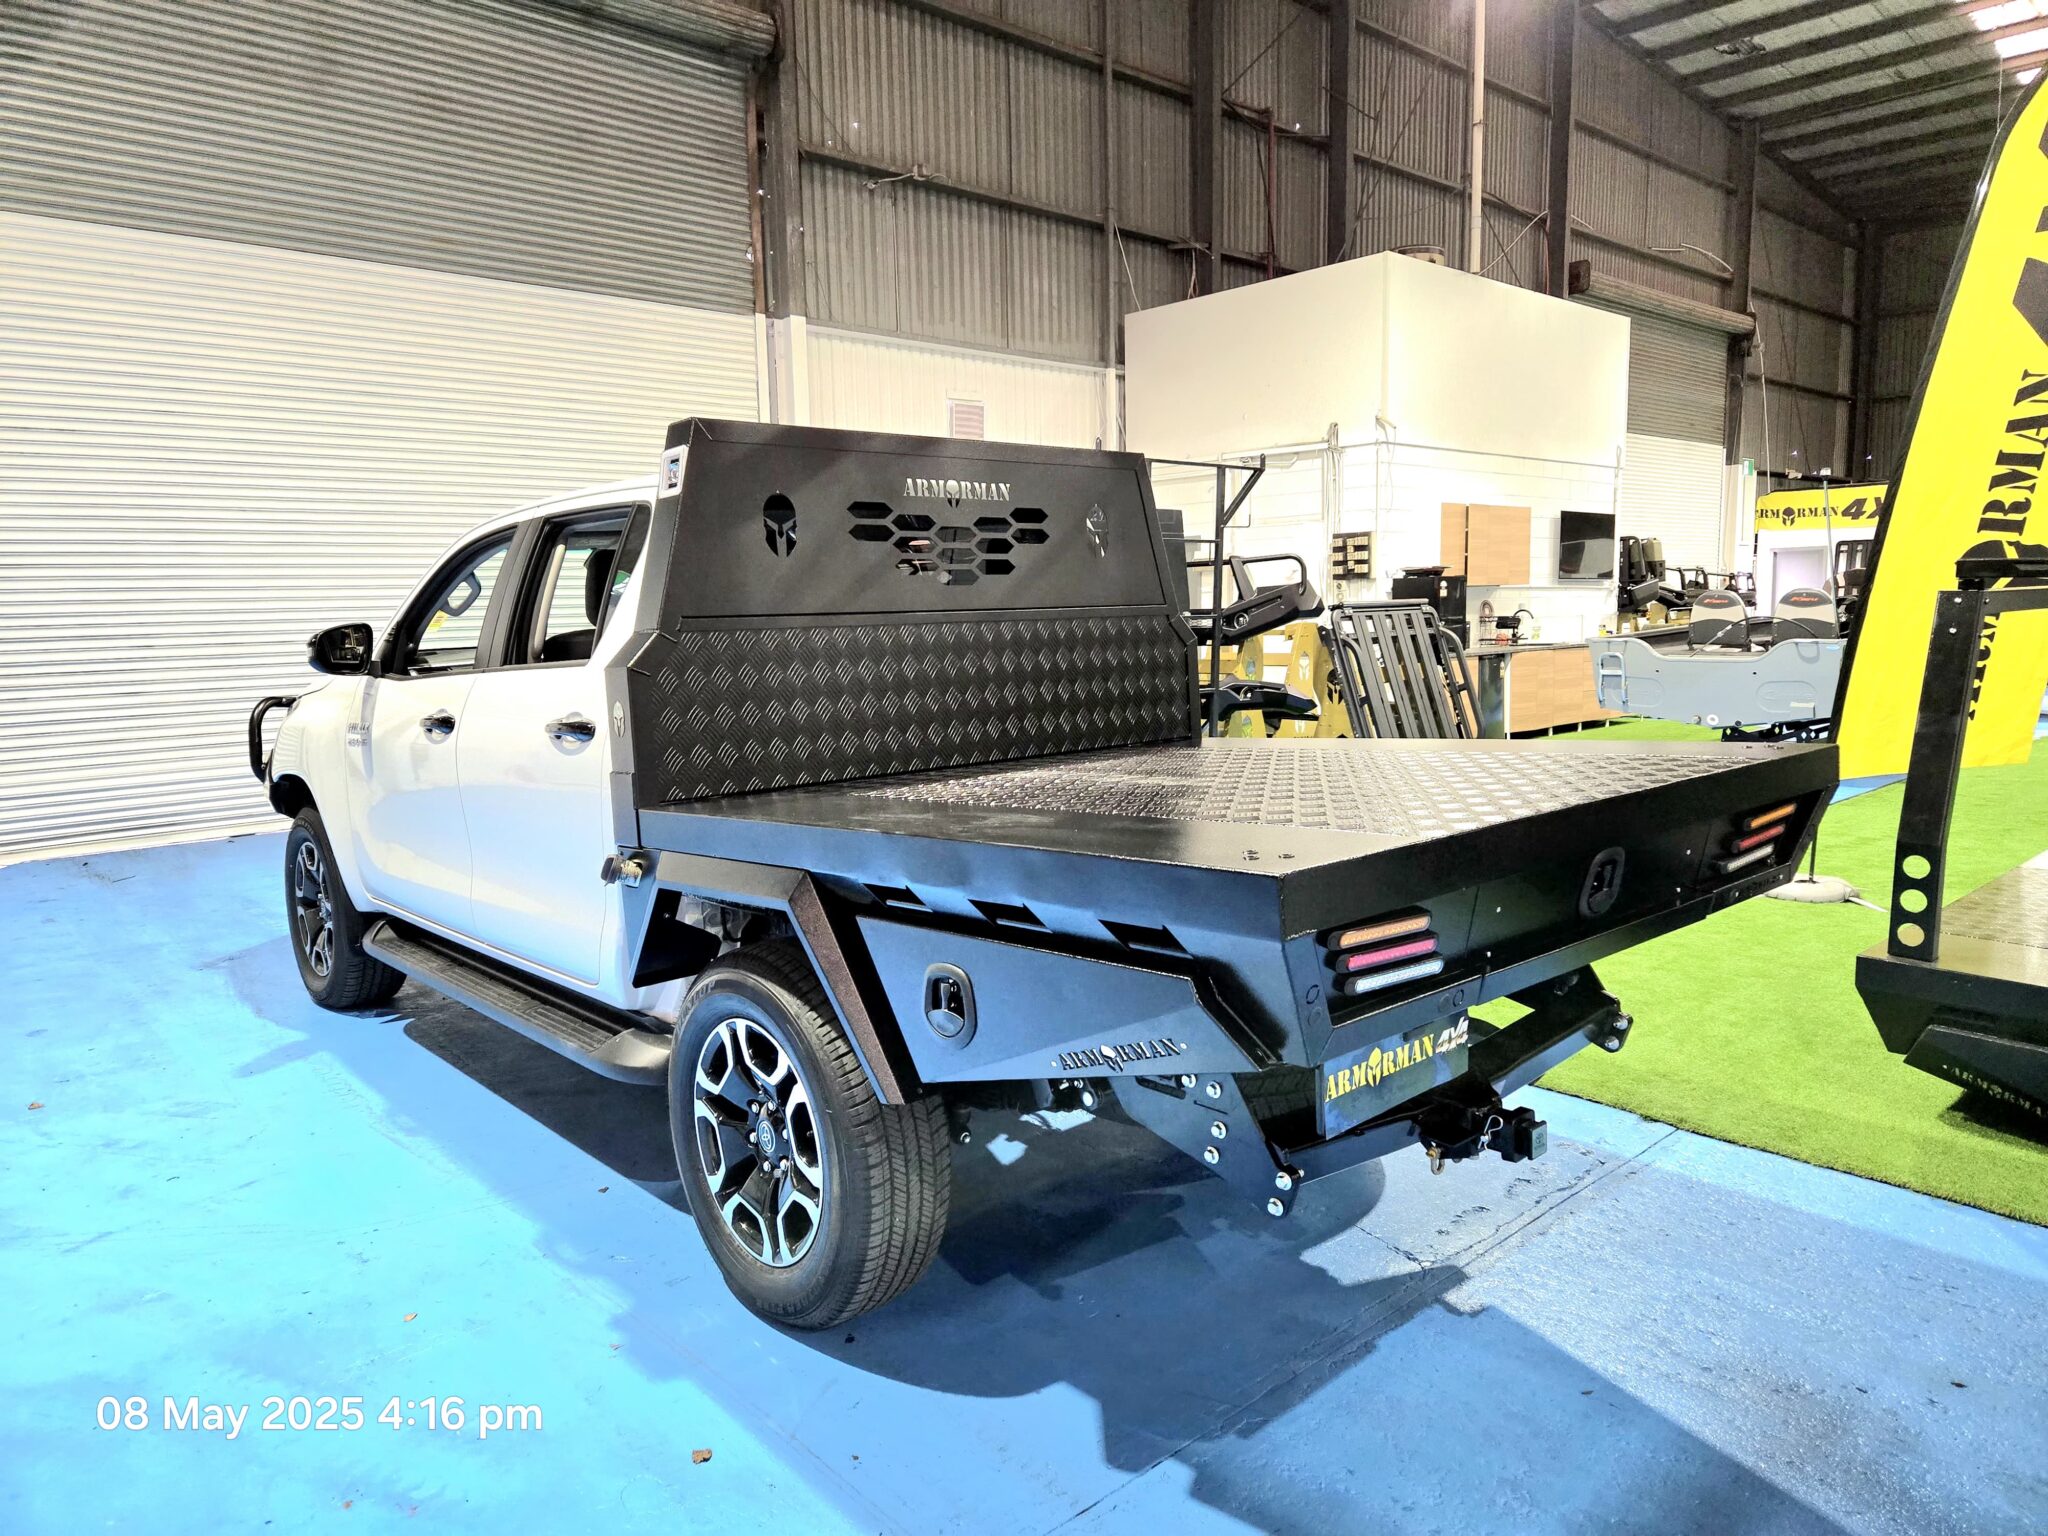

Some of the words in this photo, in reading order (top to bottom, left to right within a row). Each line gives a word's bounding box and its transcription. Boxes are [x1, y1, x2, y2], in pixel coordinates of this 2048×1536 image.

[903, 478, 1011, 508] ARMORMAN
[1059, 1039, 1180, 1072] ARMORMAN
[1325, 1033, 1435, 1103] ARMORMAN
